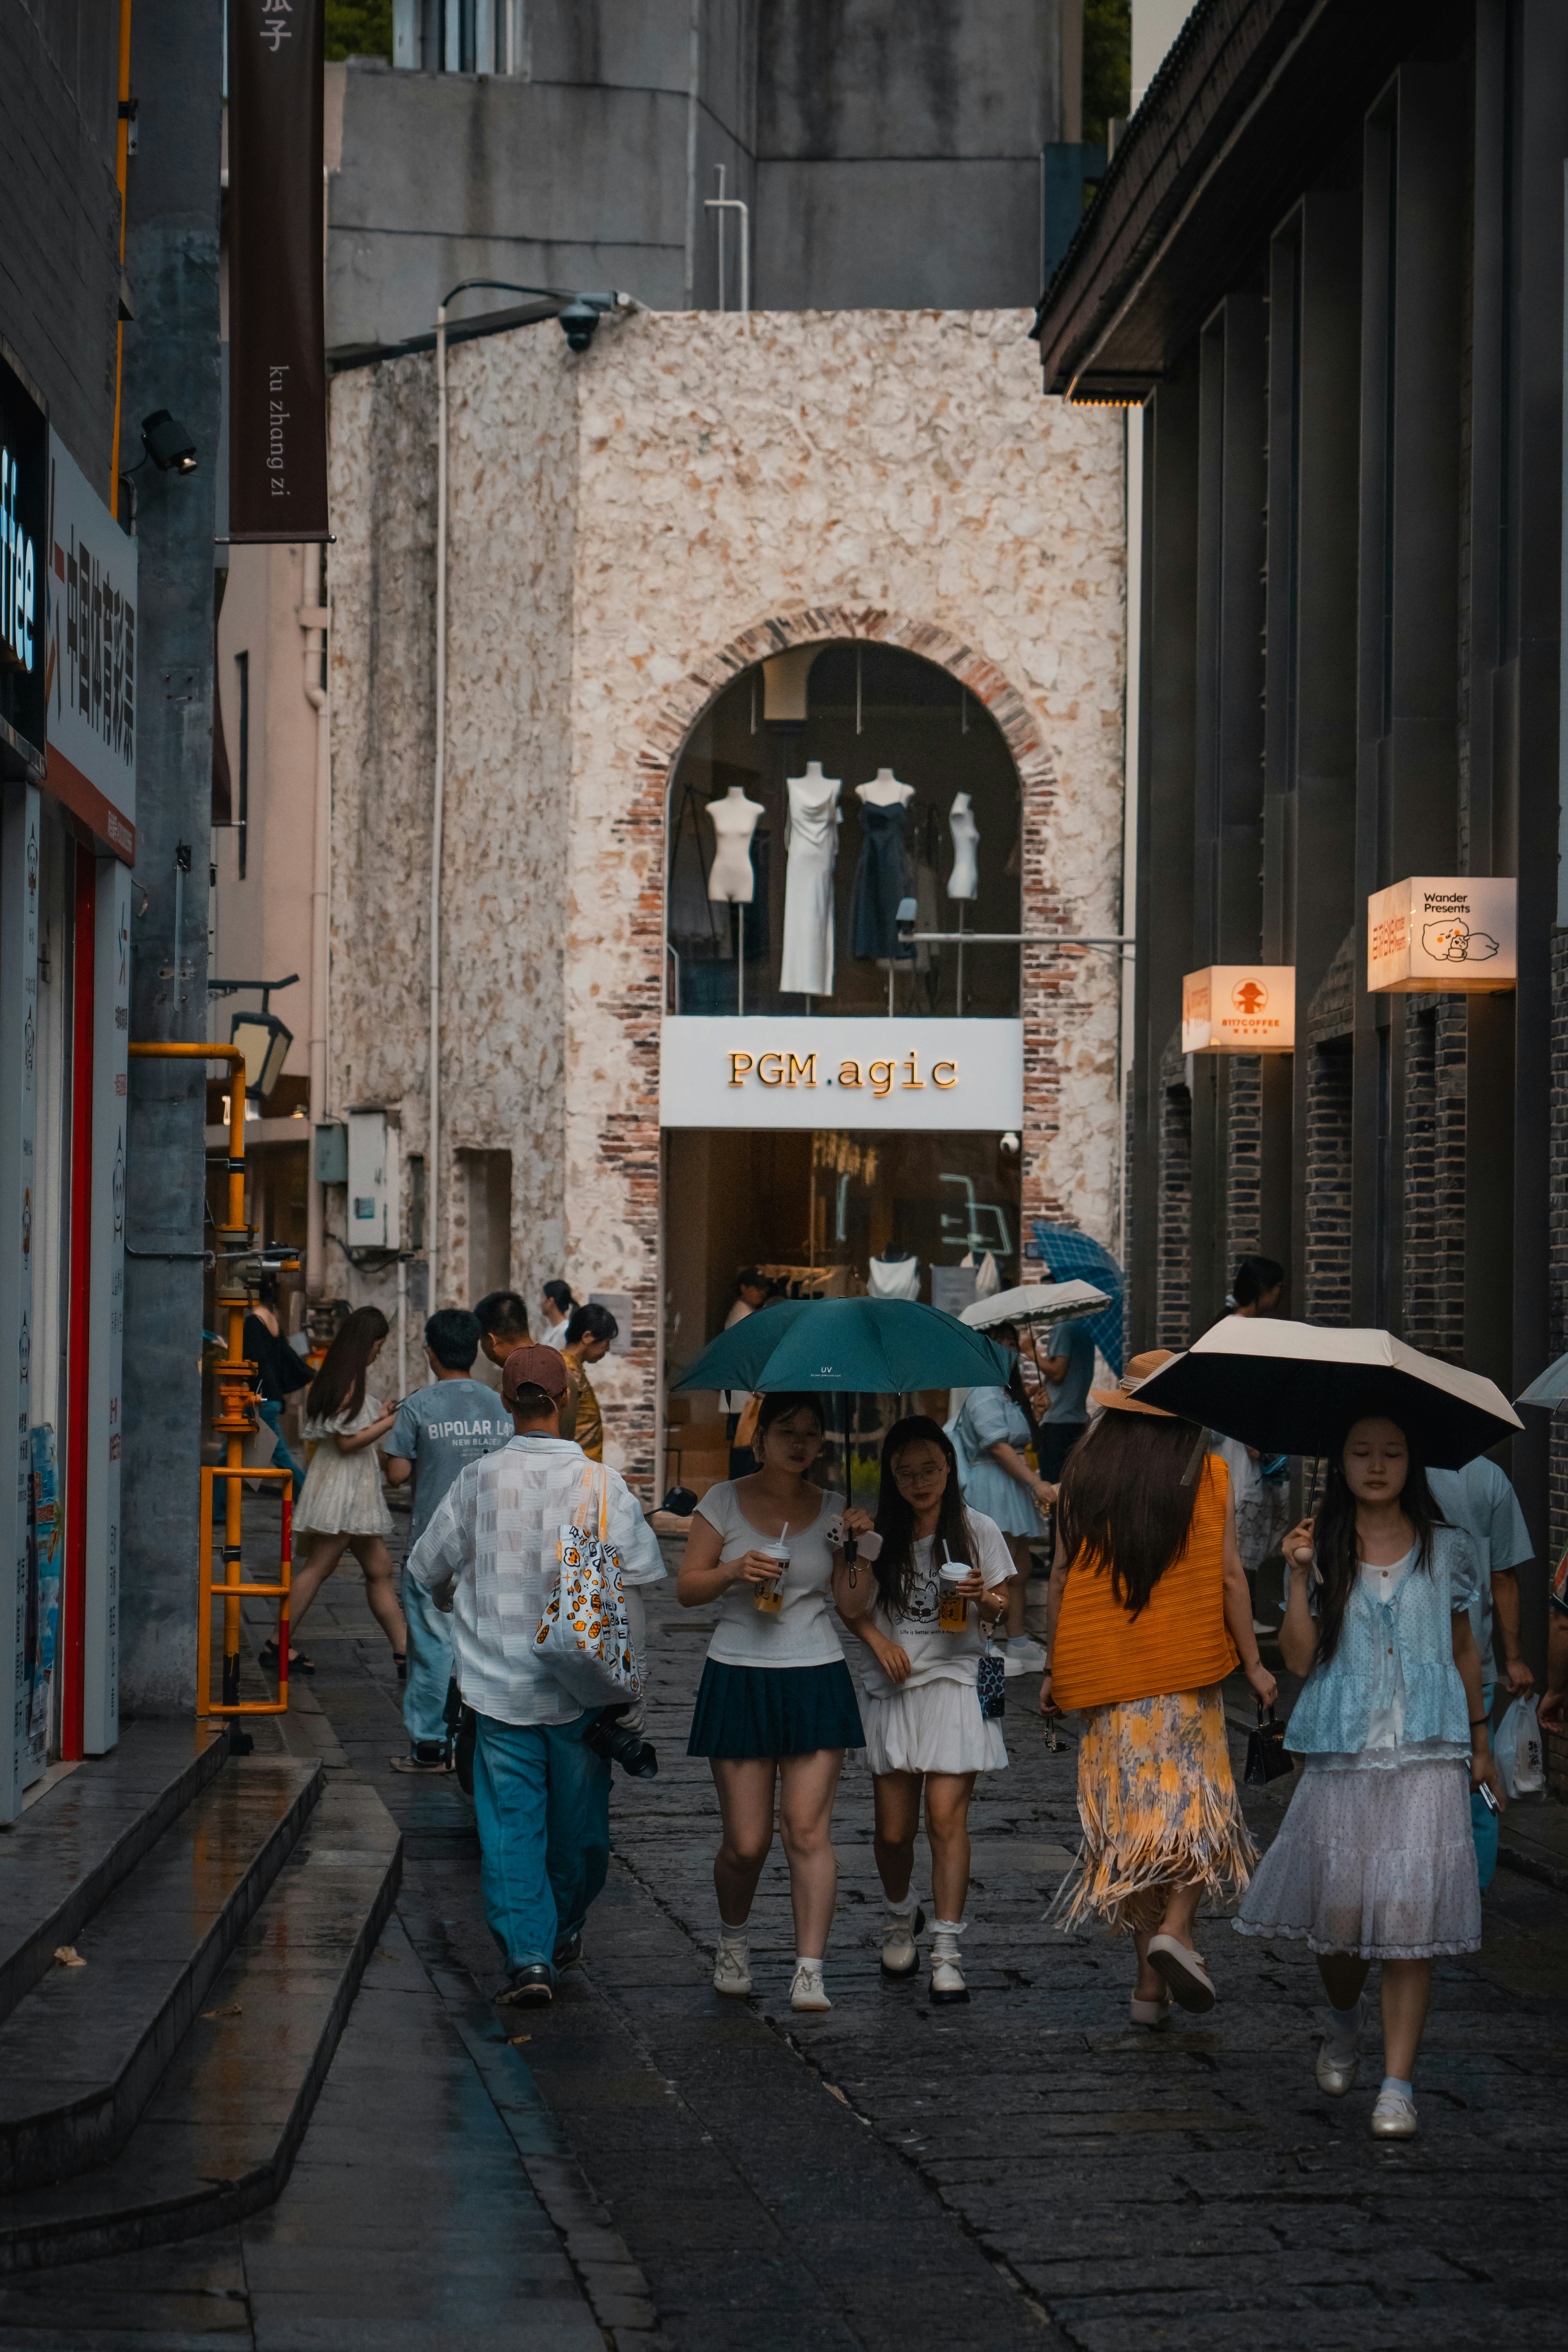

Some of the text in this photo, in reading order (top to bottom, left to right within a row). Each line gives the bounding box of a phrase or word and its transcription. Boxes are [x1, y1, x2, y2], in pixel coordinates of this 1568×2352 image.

[267, 365, 291, 497] ku zhang zi
[0, 446, 35, 673] ffee
[67, 523, 134, 766] 中国体育彩票
[1424, 893, 1468, 902] Wander
[1424, 903, 1470, 913] Presents
[727, 1050, 959, 1097] PGM.agic
[428, 1420, 491, 1439] BIPOLAR
